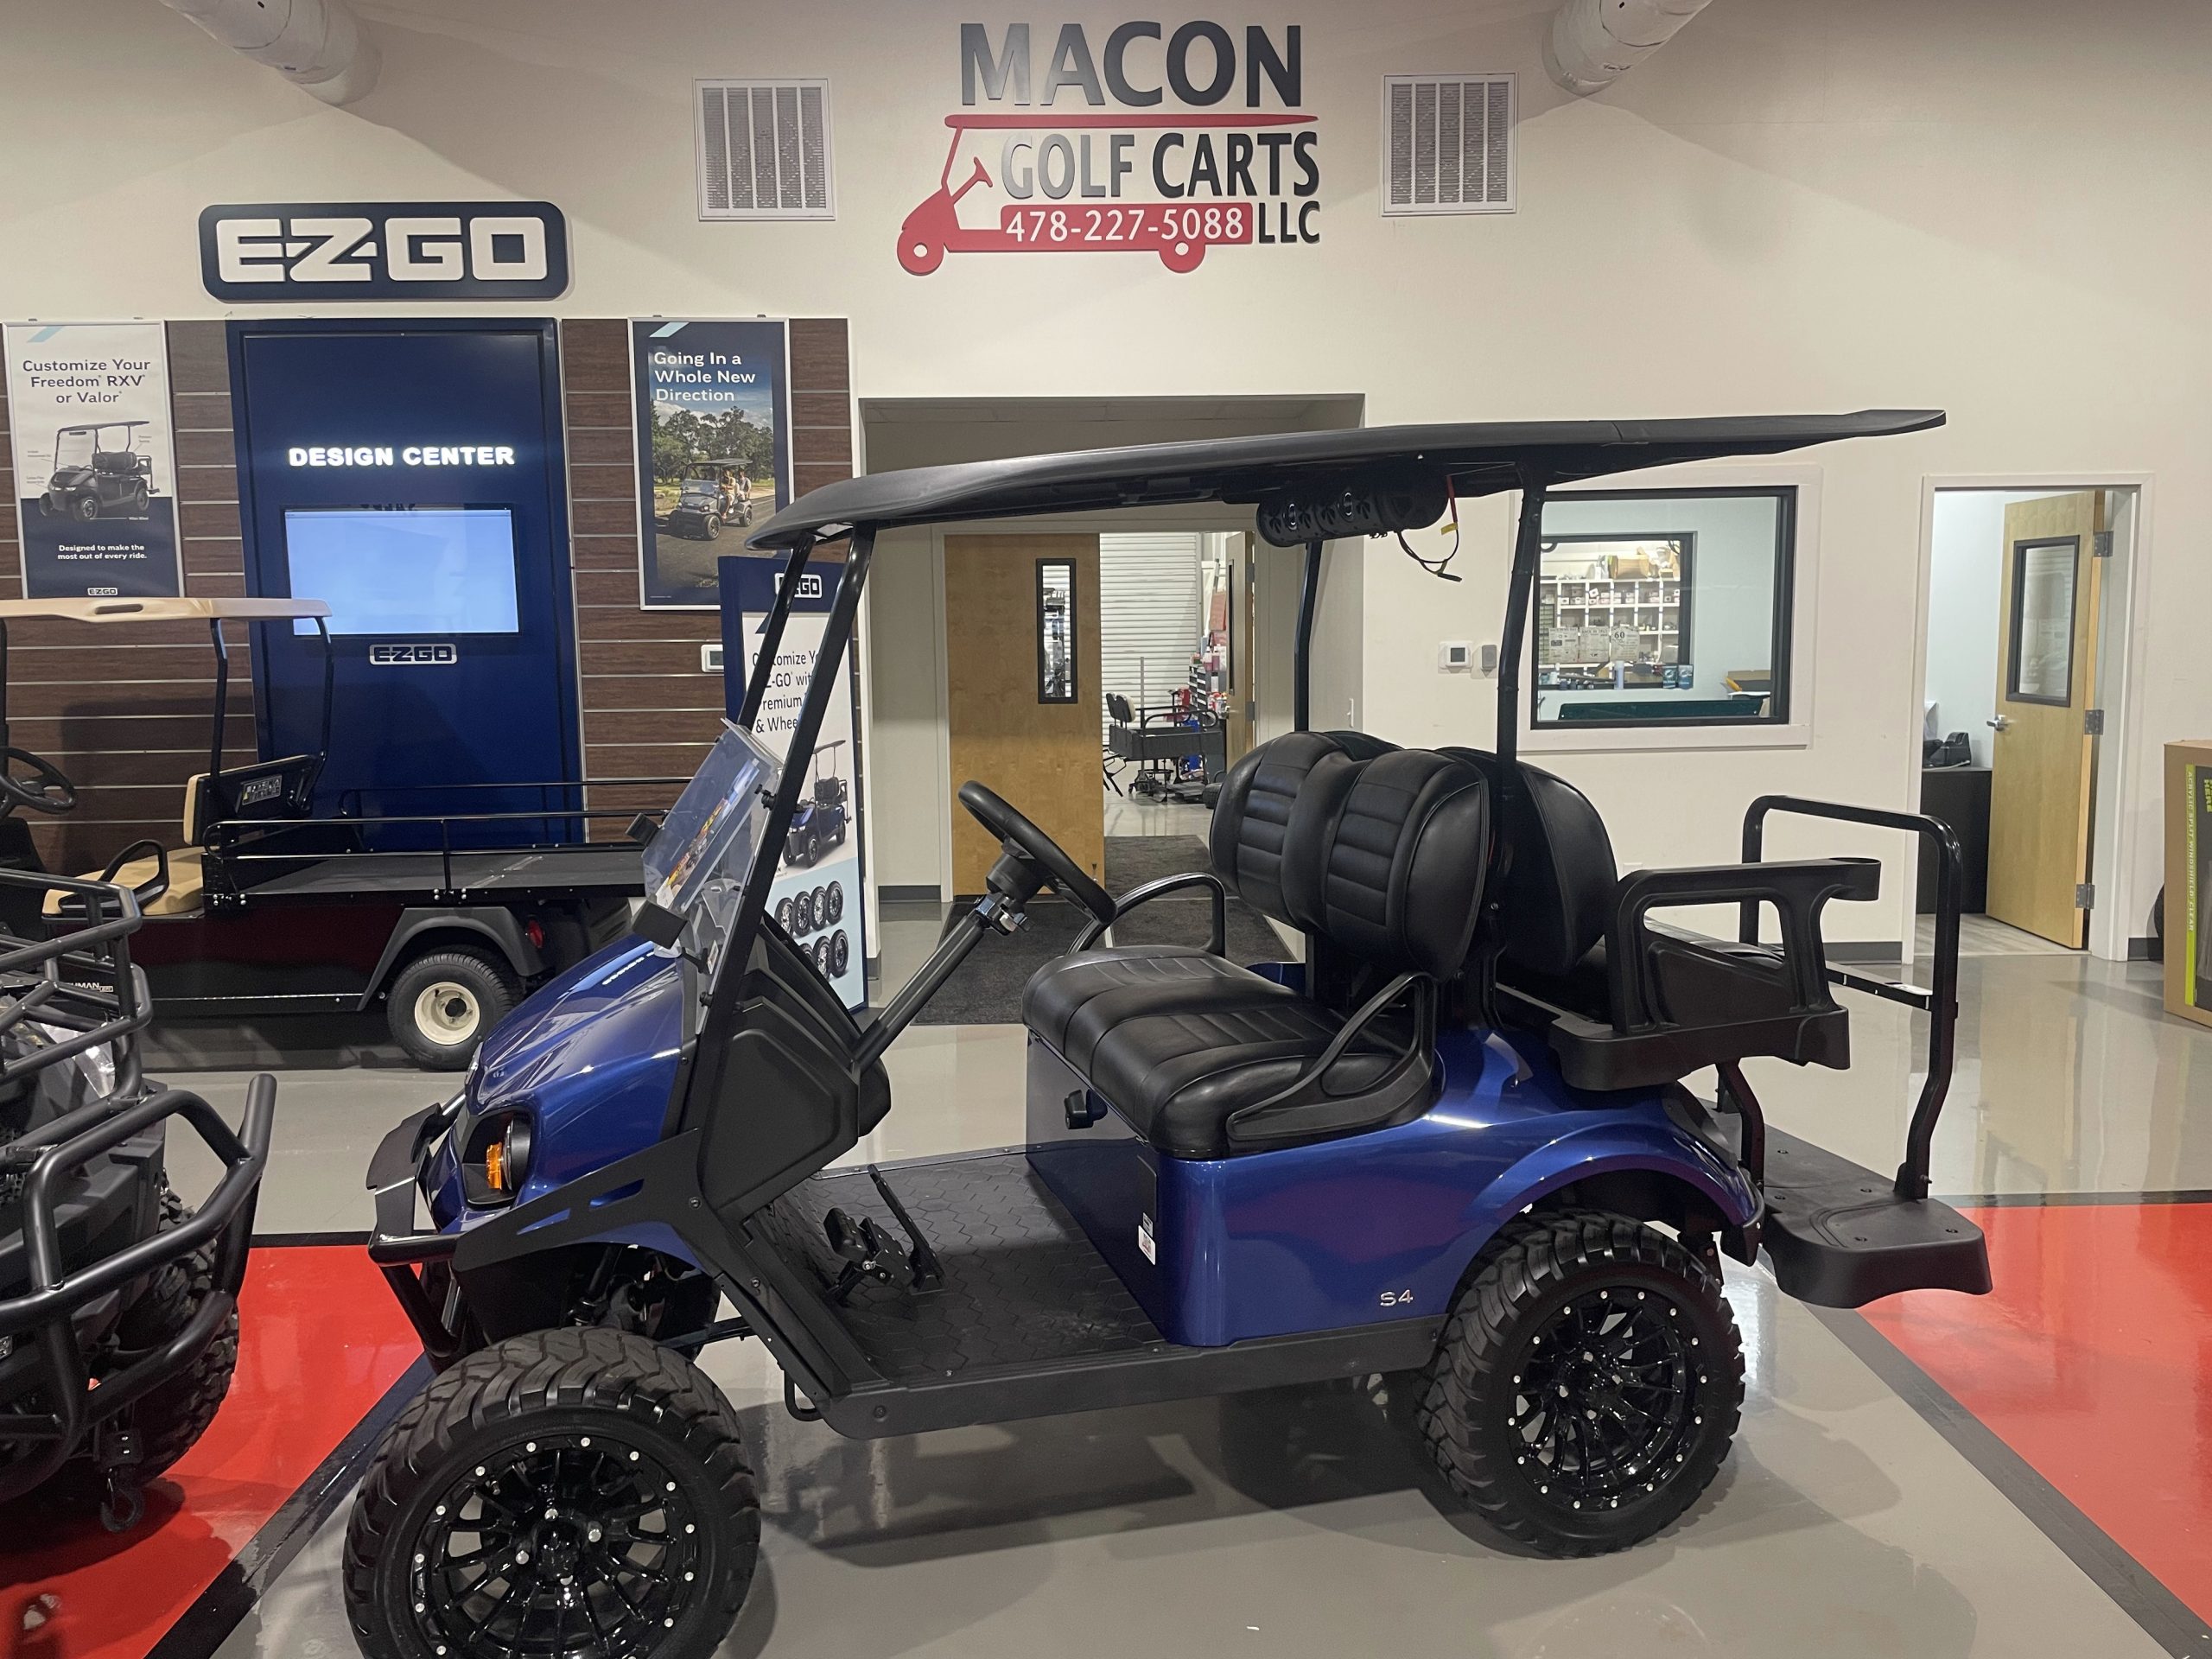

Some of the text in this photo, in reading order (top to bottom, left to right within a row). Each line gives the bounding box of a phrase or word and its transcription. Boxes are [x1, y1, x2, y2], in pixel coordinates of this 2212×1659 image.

[961, 21, 1301, 108] MACON
[1001, 132, 1320, 199] GOLF CARTS
[1006, 208, 1244, 243] 478-227-5088
[1258, 201, 1320, 244] LLC
[22, 359, 150, 372] Customize Your
[654, 352, 742, 367] Going In a
[654, 370, 755, 383] Whole New
[56, 394, 72, 403] or
[657, 389, 734, 401] Direction
[289, 446, 515, 467] DESIGN CENTER
[59, 544, 95, 553] Designed
[779, 577, 820, 594] GO
[762, 694, 802, 710] remium
[756, 716, 798, 733] & Whee
[1380, 1289, 1414, 1306] S4
